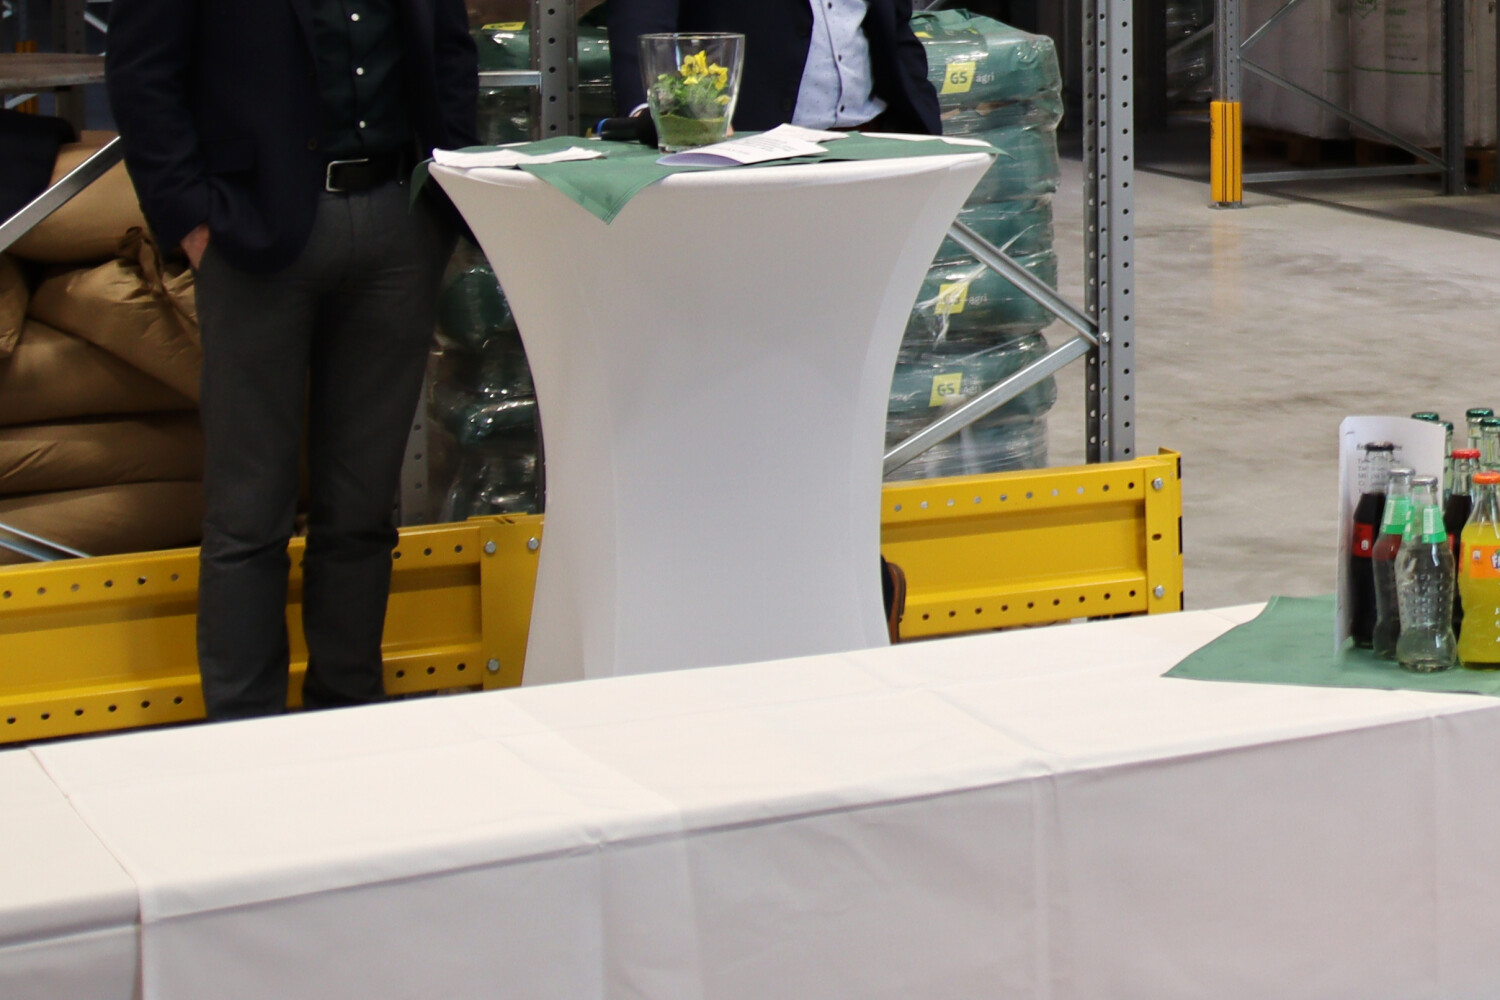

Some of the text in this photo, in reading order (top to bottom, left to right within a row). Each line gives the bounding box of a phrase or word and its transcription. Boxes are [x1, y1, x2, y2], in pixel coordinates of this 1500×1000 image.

[950, 71, 995, 85] GS agri
[968, 294, 988, 304] agri
[937, 383, 954, 395] GS
